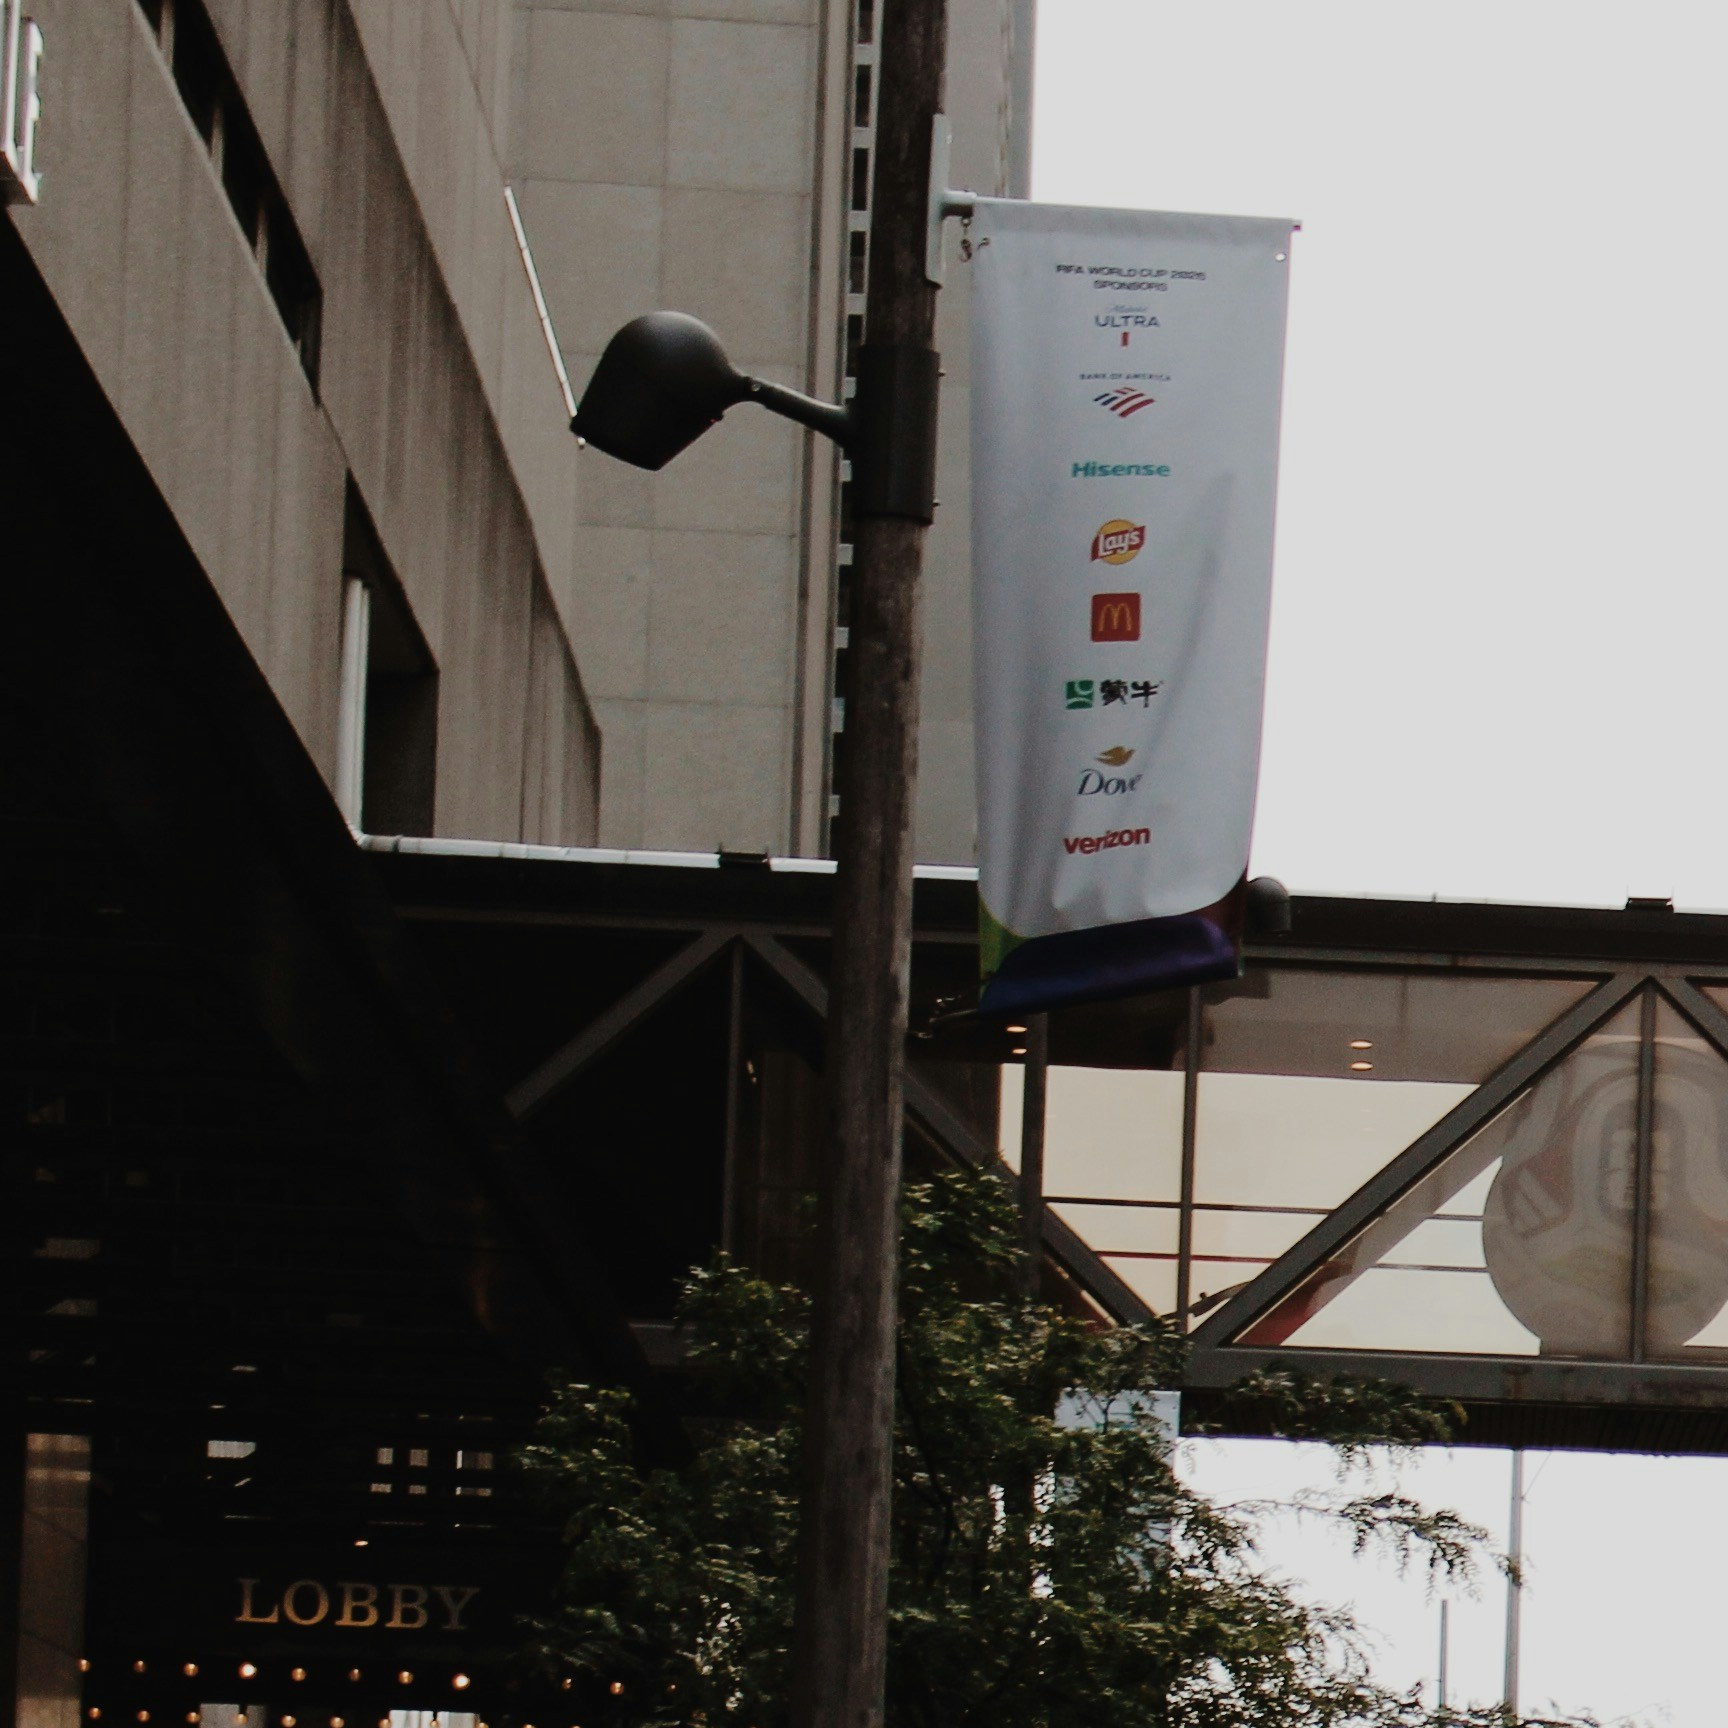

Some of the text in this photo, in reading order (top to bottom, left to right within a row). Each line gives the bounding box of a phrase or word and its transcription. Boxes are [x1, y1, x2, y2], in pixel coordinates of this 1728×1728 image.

[1056, 264, 1207, 281] FIFA WORLD CUP 2026
[1094, 279, 1169, 292] SPONSORS
[1094, 315, 1160, 328] ULTRA
[1071, 461, 1172, 478] Hisense
[1098, 528, 1142, 556] Lay's
[1100, 678, 1159, 709] 蒙牛
[1076, 768, 1144, 796] Dove
[1063, 826, 1151, 855] verizon
[235, 1577, 480, 1630] LOBBY
